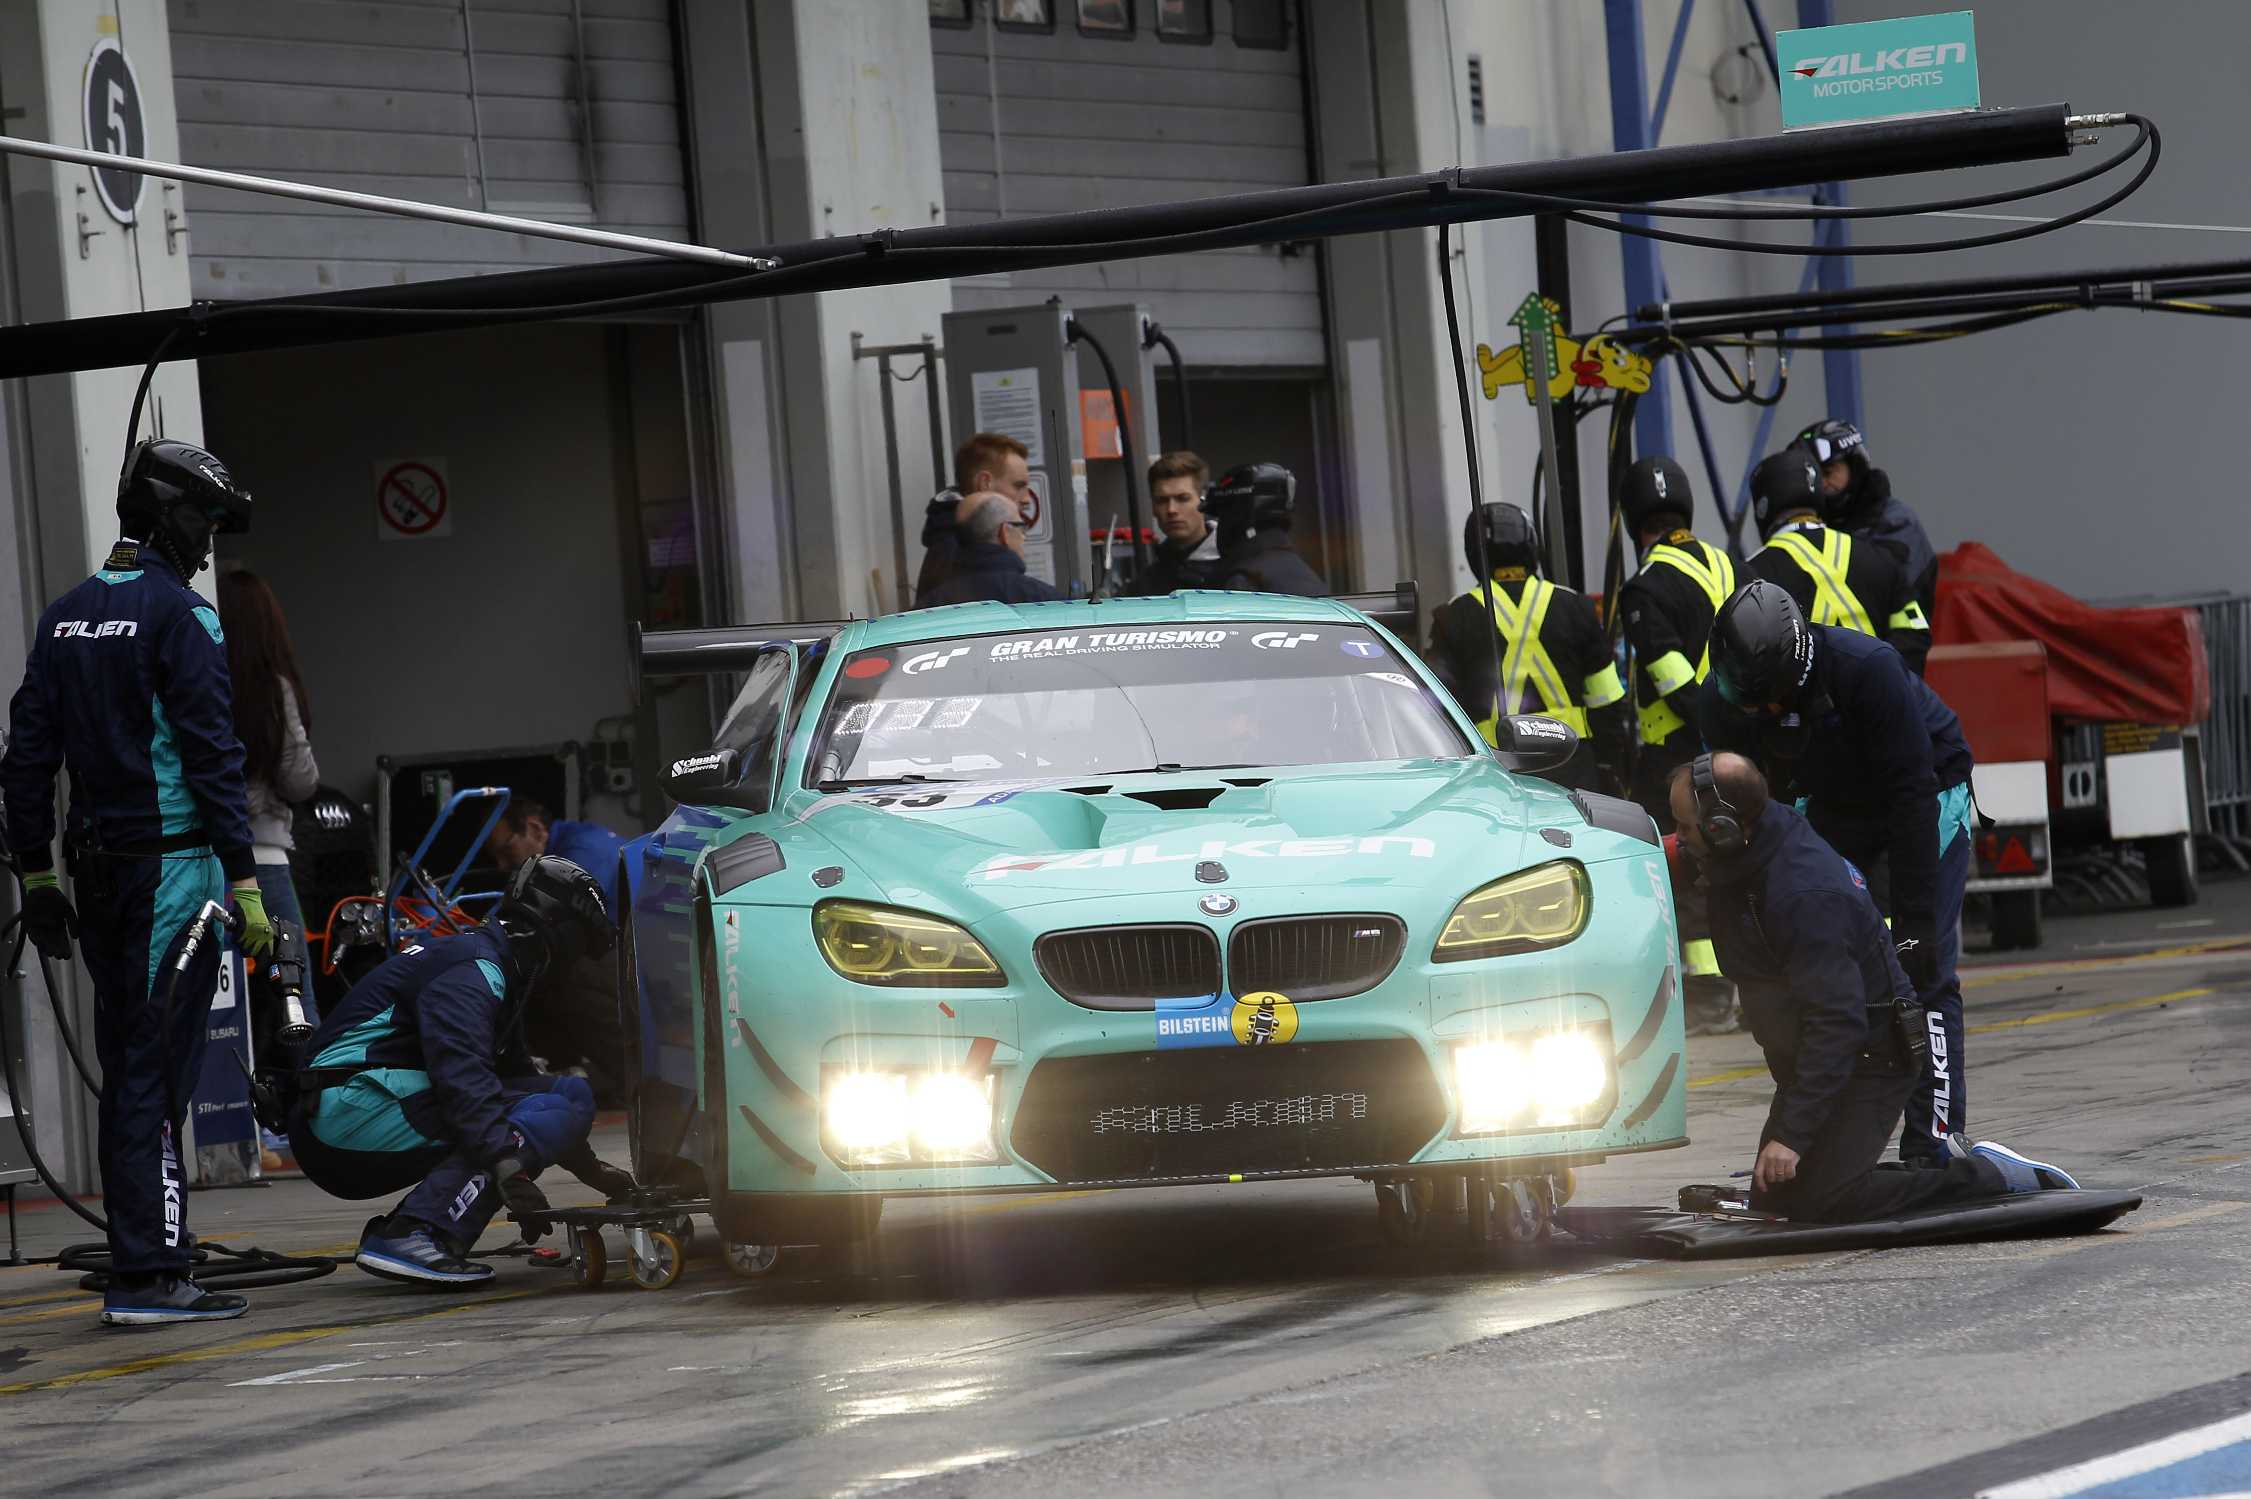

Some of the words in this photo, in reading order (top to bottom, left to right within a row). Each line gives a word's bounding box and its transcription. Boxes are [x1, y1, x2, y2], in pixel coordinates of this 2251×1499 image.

[1790, 42, 1967, 81] FALKEN
[1813, 70, 1943, 97] MOTORSPORTS
[106, 78, 127, 173] 5
[988, 656, 1020, 664] THE
[1023, 651, 1063, 660] REAL
[1066, 645, 1130, 655] DRIVING
[1132, 642, 1221, 652] SIMULATOR
[990, 636, 1080, 657] GRAN
[1087, 630, 1229, 647] TURISMO
[1347, 640, 1371, 656] T
[983, 836, 1436, 880] FALKEN
[1159, 1015, 1230, 1036] BILSTEIN
[1926, 1010, 1951, 1140] FALKEN
[159, 1118, 181, 1248] FALKEN
